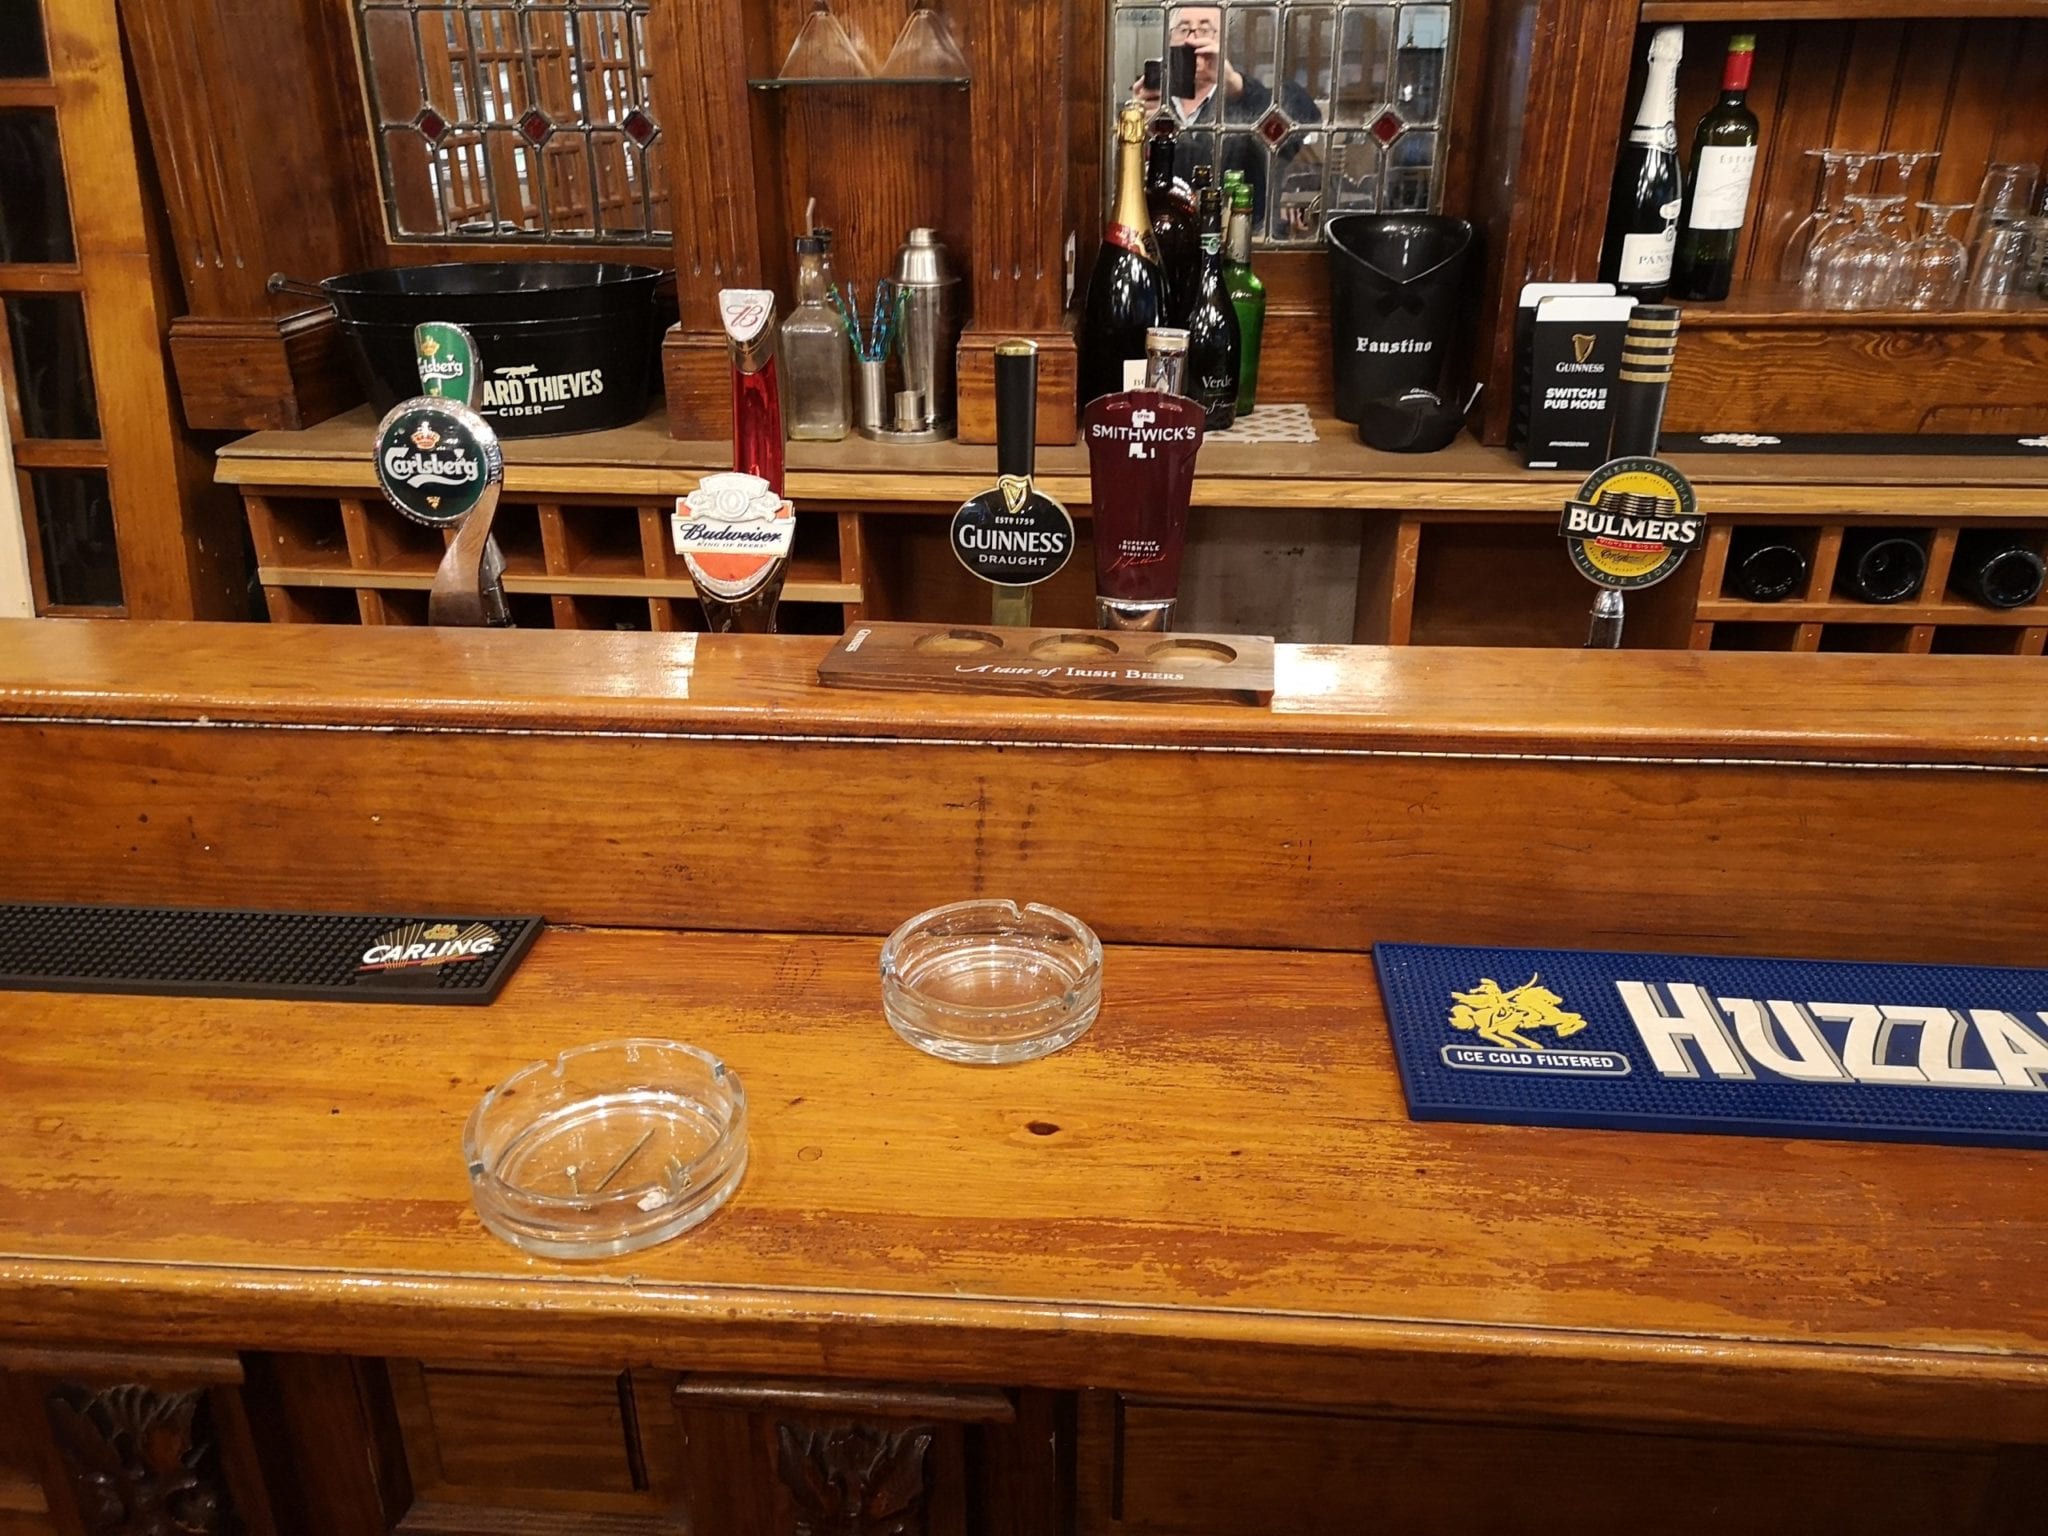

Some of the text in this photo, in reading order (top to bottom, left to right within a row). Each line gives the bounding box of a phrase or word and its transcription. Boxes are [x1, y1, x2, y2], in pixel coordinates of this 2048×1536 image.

[1356, 336, 1432, 353] Faustino
[1555, 362, 1605, 373] GUINNESS
[480, 379, 523, 406] ARD
[524, 368, 603, 402] THIEVES
[1545, 387, 1597, 399] SWITCH
[499, 404, 542, 417] CIDER
[1543, 399, 1606, 410] PUB MODE
[1092, 424, 1196, 441] SMITHWICK'S
[385, 446, 479, 488] Carlsberg
[1015, 517, 1035, 526] 1759
[1567, 507, 1699, 544] BULMERS
[680, 523, 782, 542] Budweiser
[958, 524, 1064, 554] GUINNESS
[1143, 544, 1160, 552] ALE
[978, 554, 1047, 566] DRAUGHT
[1574, 545, 1627, 585] VINTAGE
[992, 665, 1034, 675] taste
[1036, 666, 1062, 678] of
[1065, 666, 1117, 678] IRISH
[1125, 668, 1185, 681] BEERS
[1457, 1050, 1613, 1069] ICE COLD FILTERED
